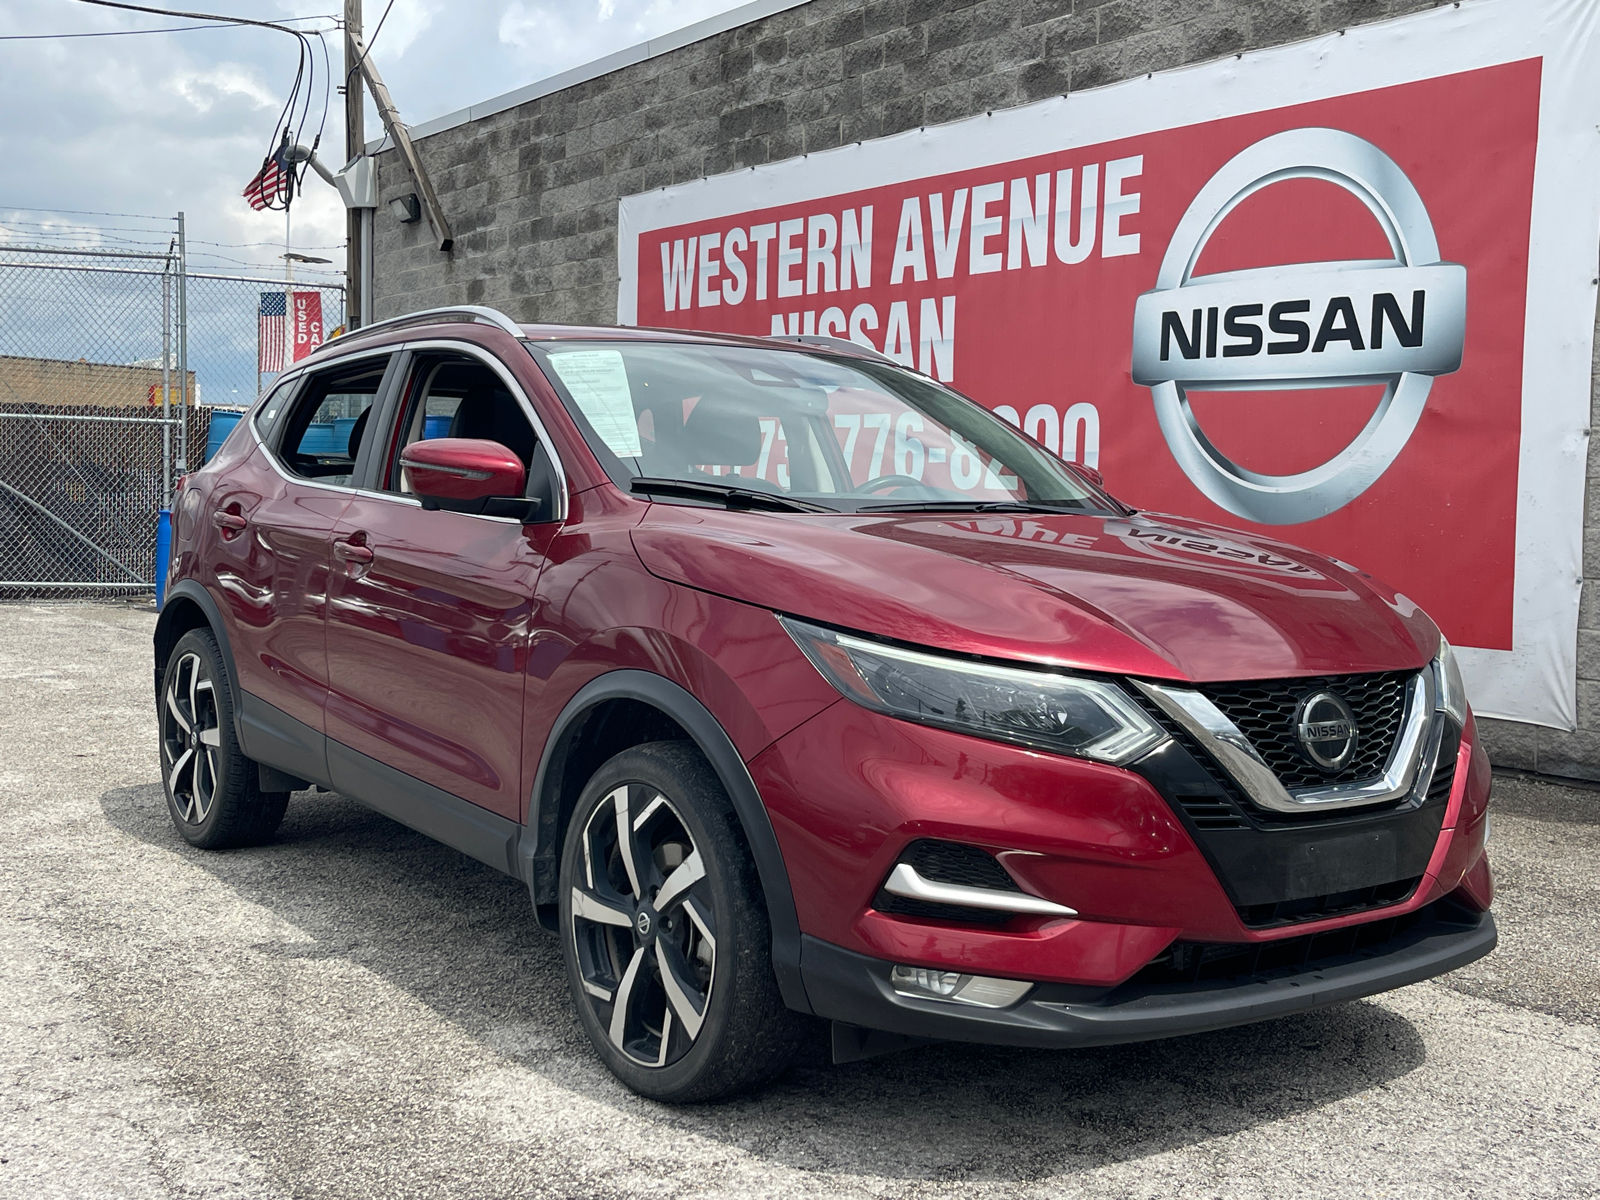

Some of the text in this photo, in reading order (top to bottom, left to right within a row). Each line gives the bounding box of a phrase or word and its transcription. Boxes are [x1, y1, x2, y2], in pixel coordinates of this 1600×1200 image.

[660, 155, 1143, 312] WESTERN AVENUE
[297, 299, 307, 344] USED
[771, 296, 956, 382] SAN
[1159, 290, 1425, 361] NISSAN
[1307, 724, 1350, 738] NISSAN
